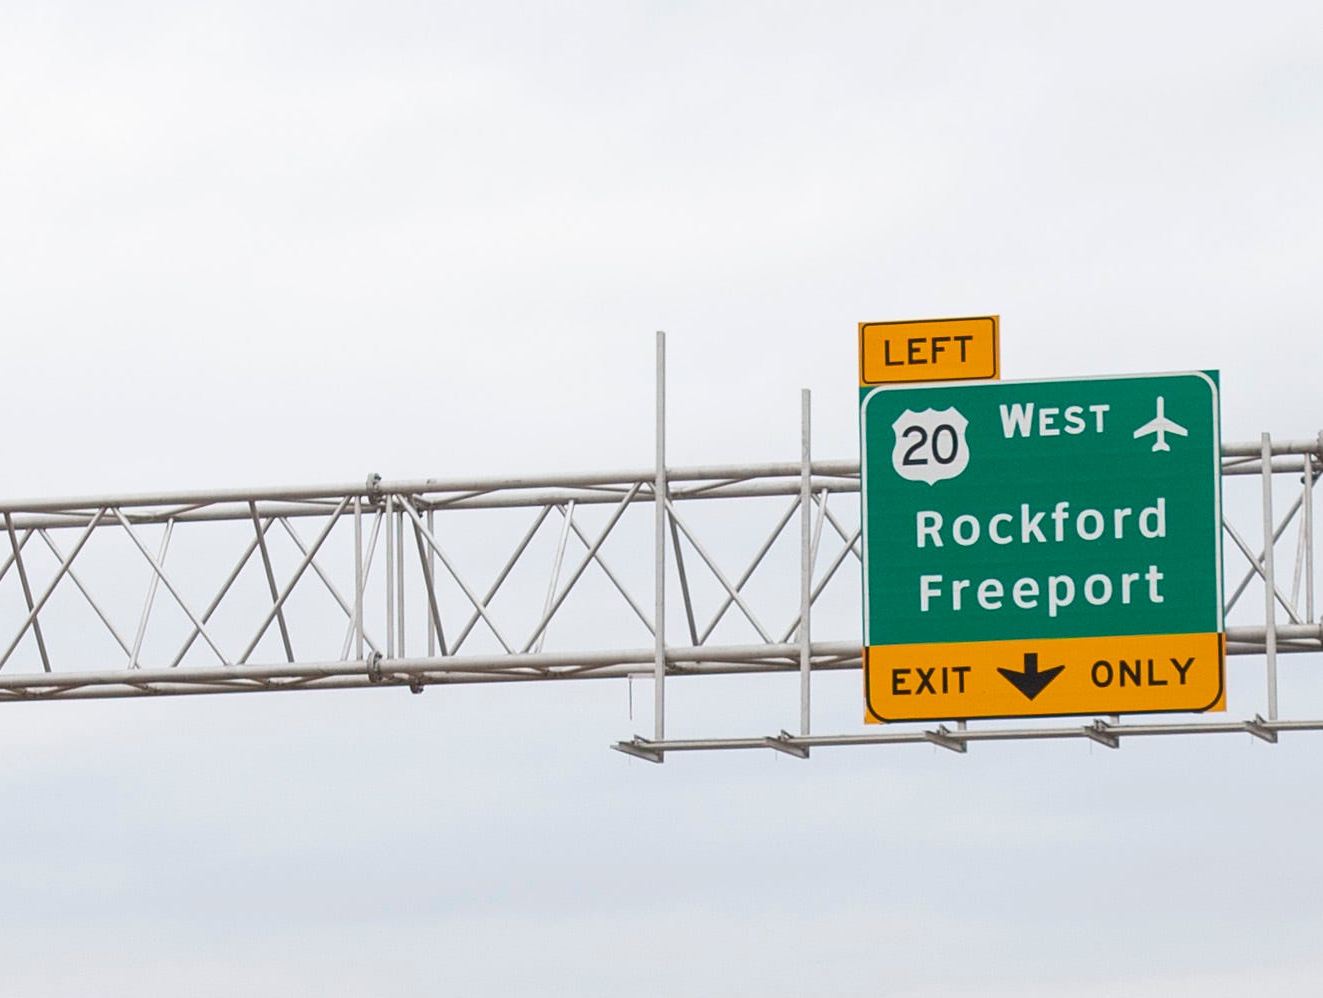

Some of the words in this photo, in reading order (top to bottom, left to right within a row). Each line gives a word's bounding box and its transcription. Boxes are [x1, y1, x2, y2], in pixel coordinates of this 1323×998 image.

[884, 335, 973, 366] LEFT
[901, 424, 959, 466] 20
[999, 402, 1110, 439] WEST
[916, 497, 1166, 548] Rockford
[920, 565, 1164, 618] Freeport
[892, 665, 972, 696] EXIT
[1091, 657, 1195, 688] ONLY
